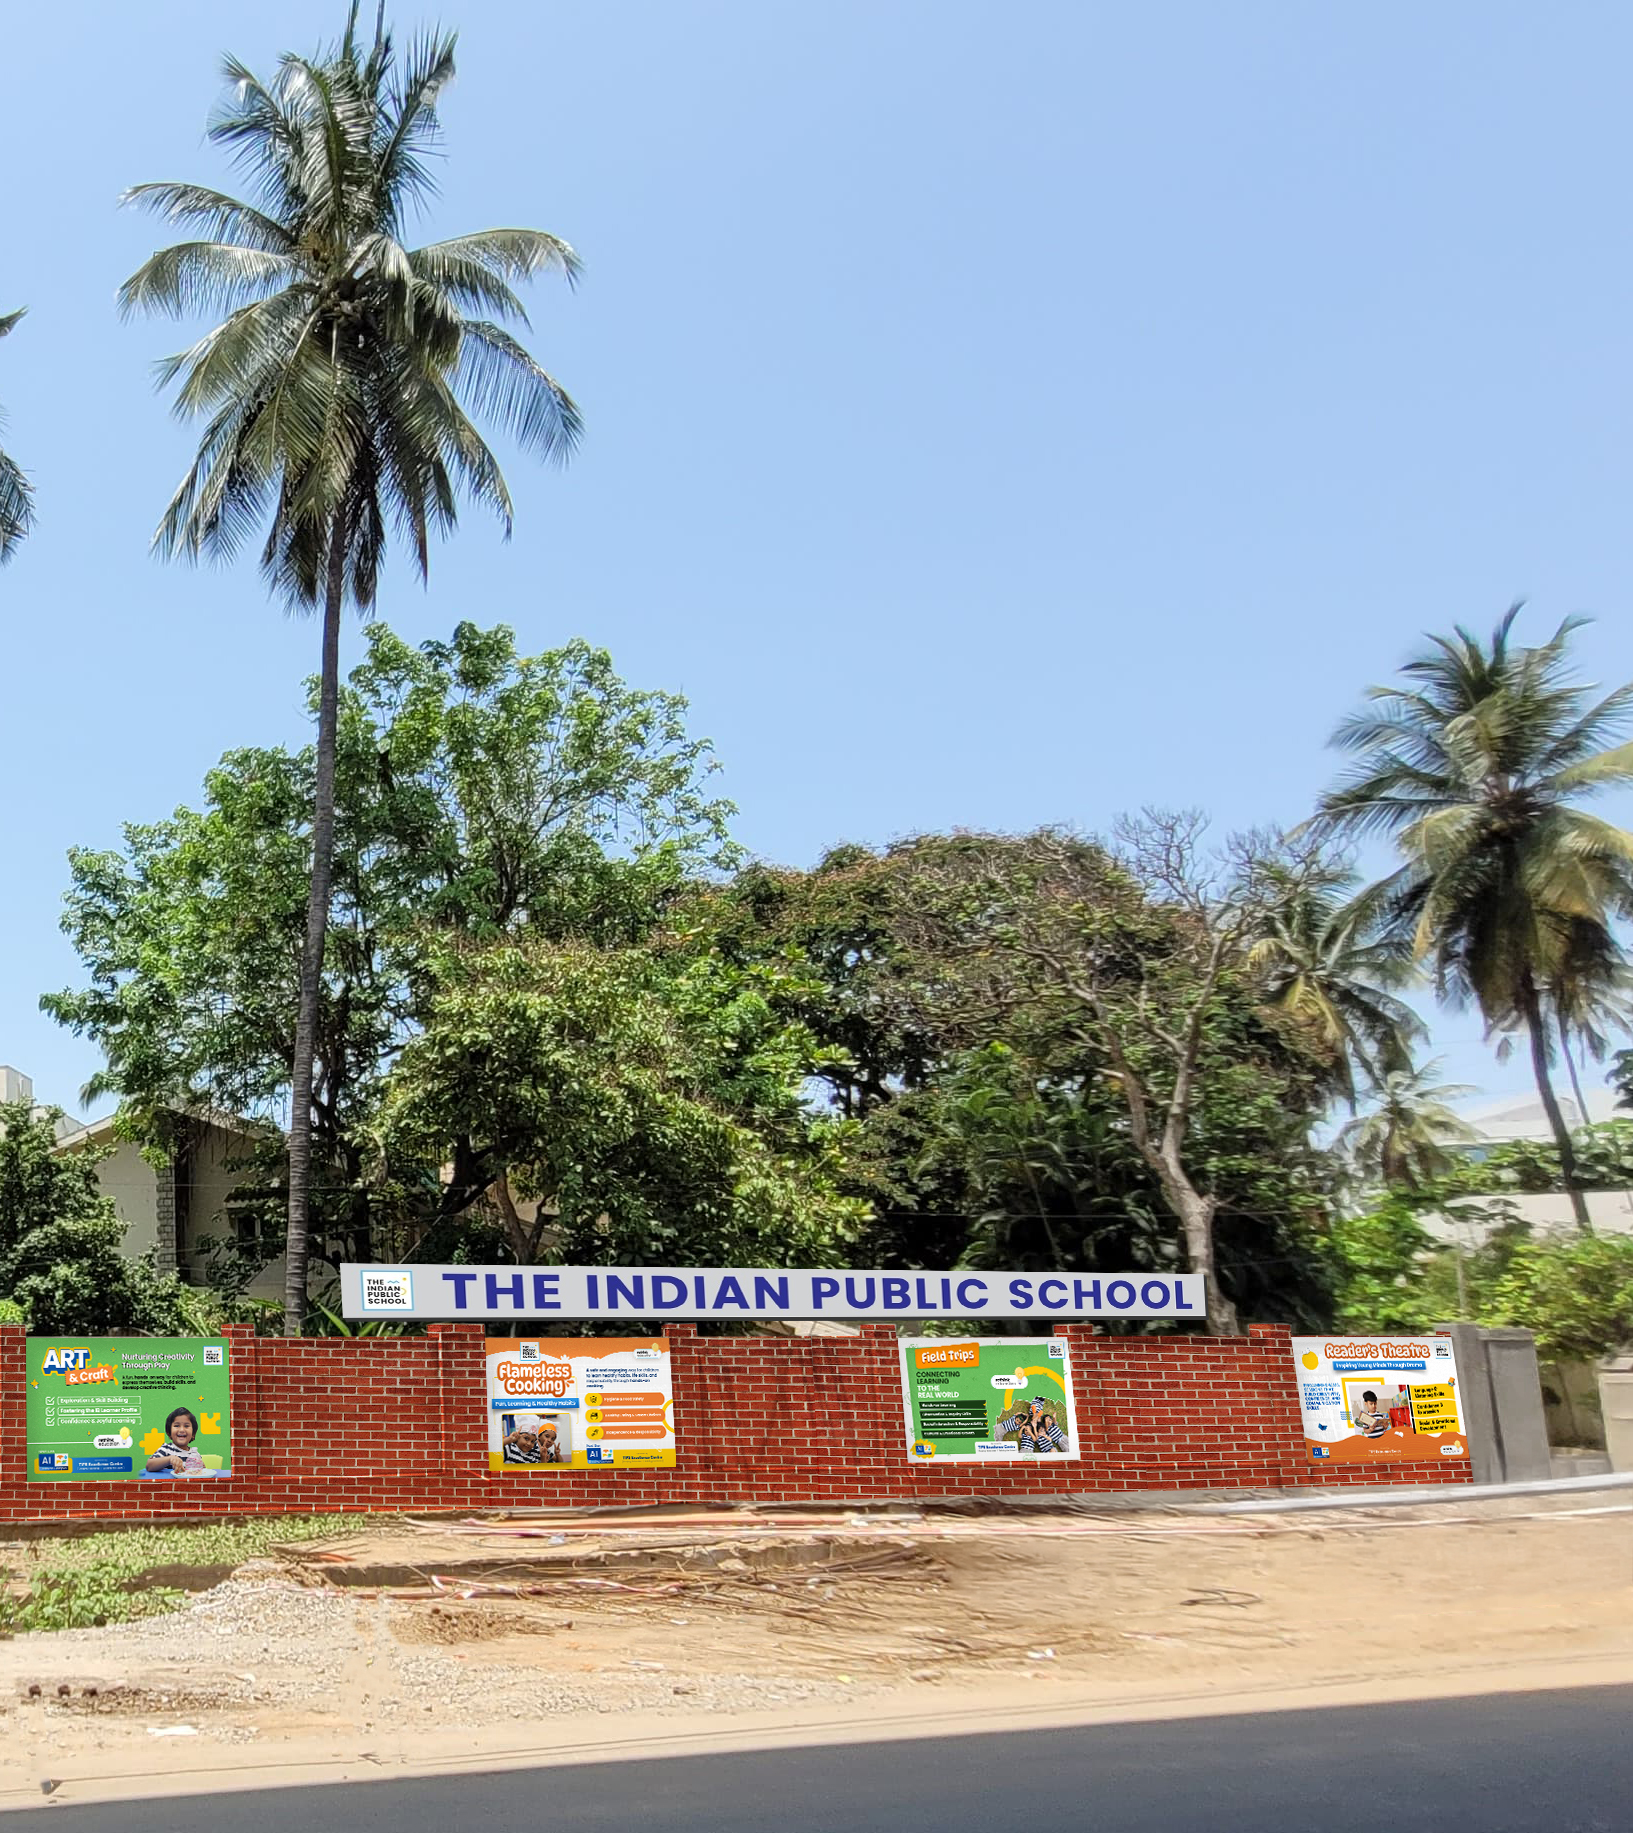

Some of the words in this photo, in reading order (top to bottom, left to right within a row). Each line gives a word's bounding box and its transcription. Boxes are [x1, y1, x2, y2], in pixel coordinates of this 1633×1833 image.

[443, 1274, 561, 1309] THE
[587, 1275, 789, 1309] INDIAN
[812, 1278, 988, 1309] PUBLIC
[1010, 1280, 1193, 1310] SCHOOL
[122, 1353, 157, 1362] Nurturing
[159, 1353, 195, 1362] Creativity
[921, 1351, 947, 1363] Field
[948, 1349, 974, 1363] Trips
[1325, 1343, 1378, 1358] Reader's
[1380, 1343, 1430, 1358] Theatre
[43, 1349, 90, 1371] ART
[122, 1362, 153, 1371] Through
[154, 1362, 170, 1371] Play
[69, 1373, 78, 1382] &
[80, 1368, 108, 1380] Craft
[499, 1363, 570, 1379] Flameless
[507, 1378, 563, 1394] Cooking
[42, 1457, 51, 1465] AI
